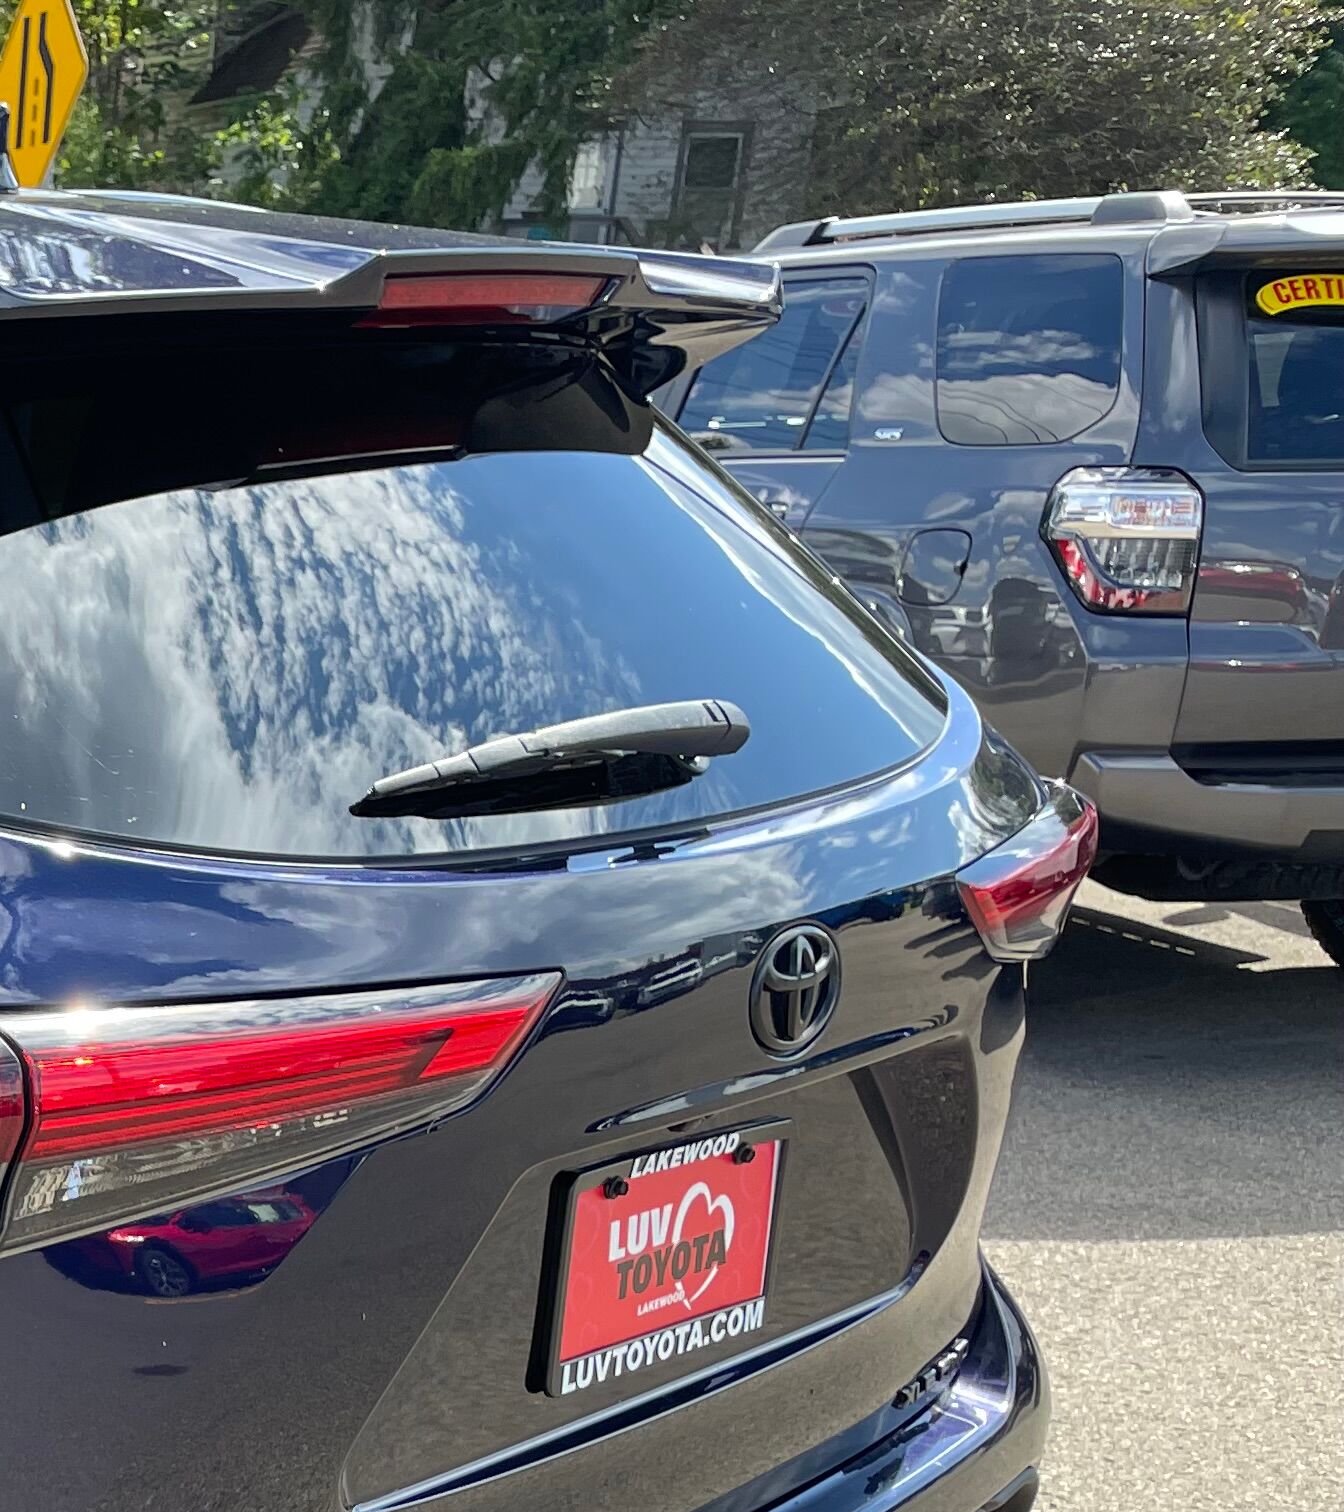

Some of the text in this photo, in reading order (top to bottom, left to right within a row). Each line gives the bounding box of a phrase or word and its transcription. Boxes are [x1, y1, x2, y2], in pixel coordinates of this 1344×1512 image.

[630, 1132, 740, 1179] LAKEWOOD
[608, 1203, 674, 1263] LUV
[617, 1228, 727, 1300] TOYOTA
[637, 1289, 686, 1317] LAKEWOOD
[560, 1300, 766, 1395] LUVTOYOTA.COM
